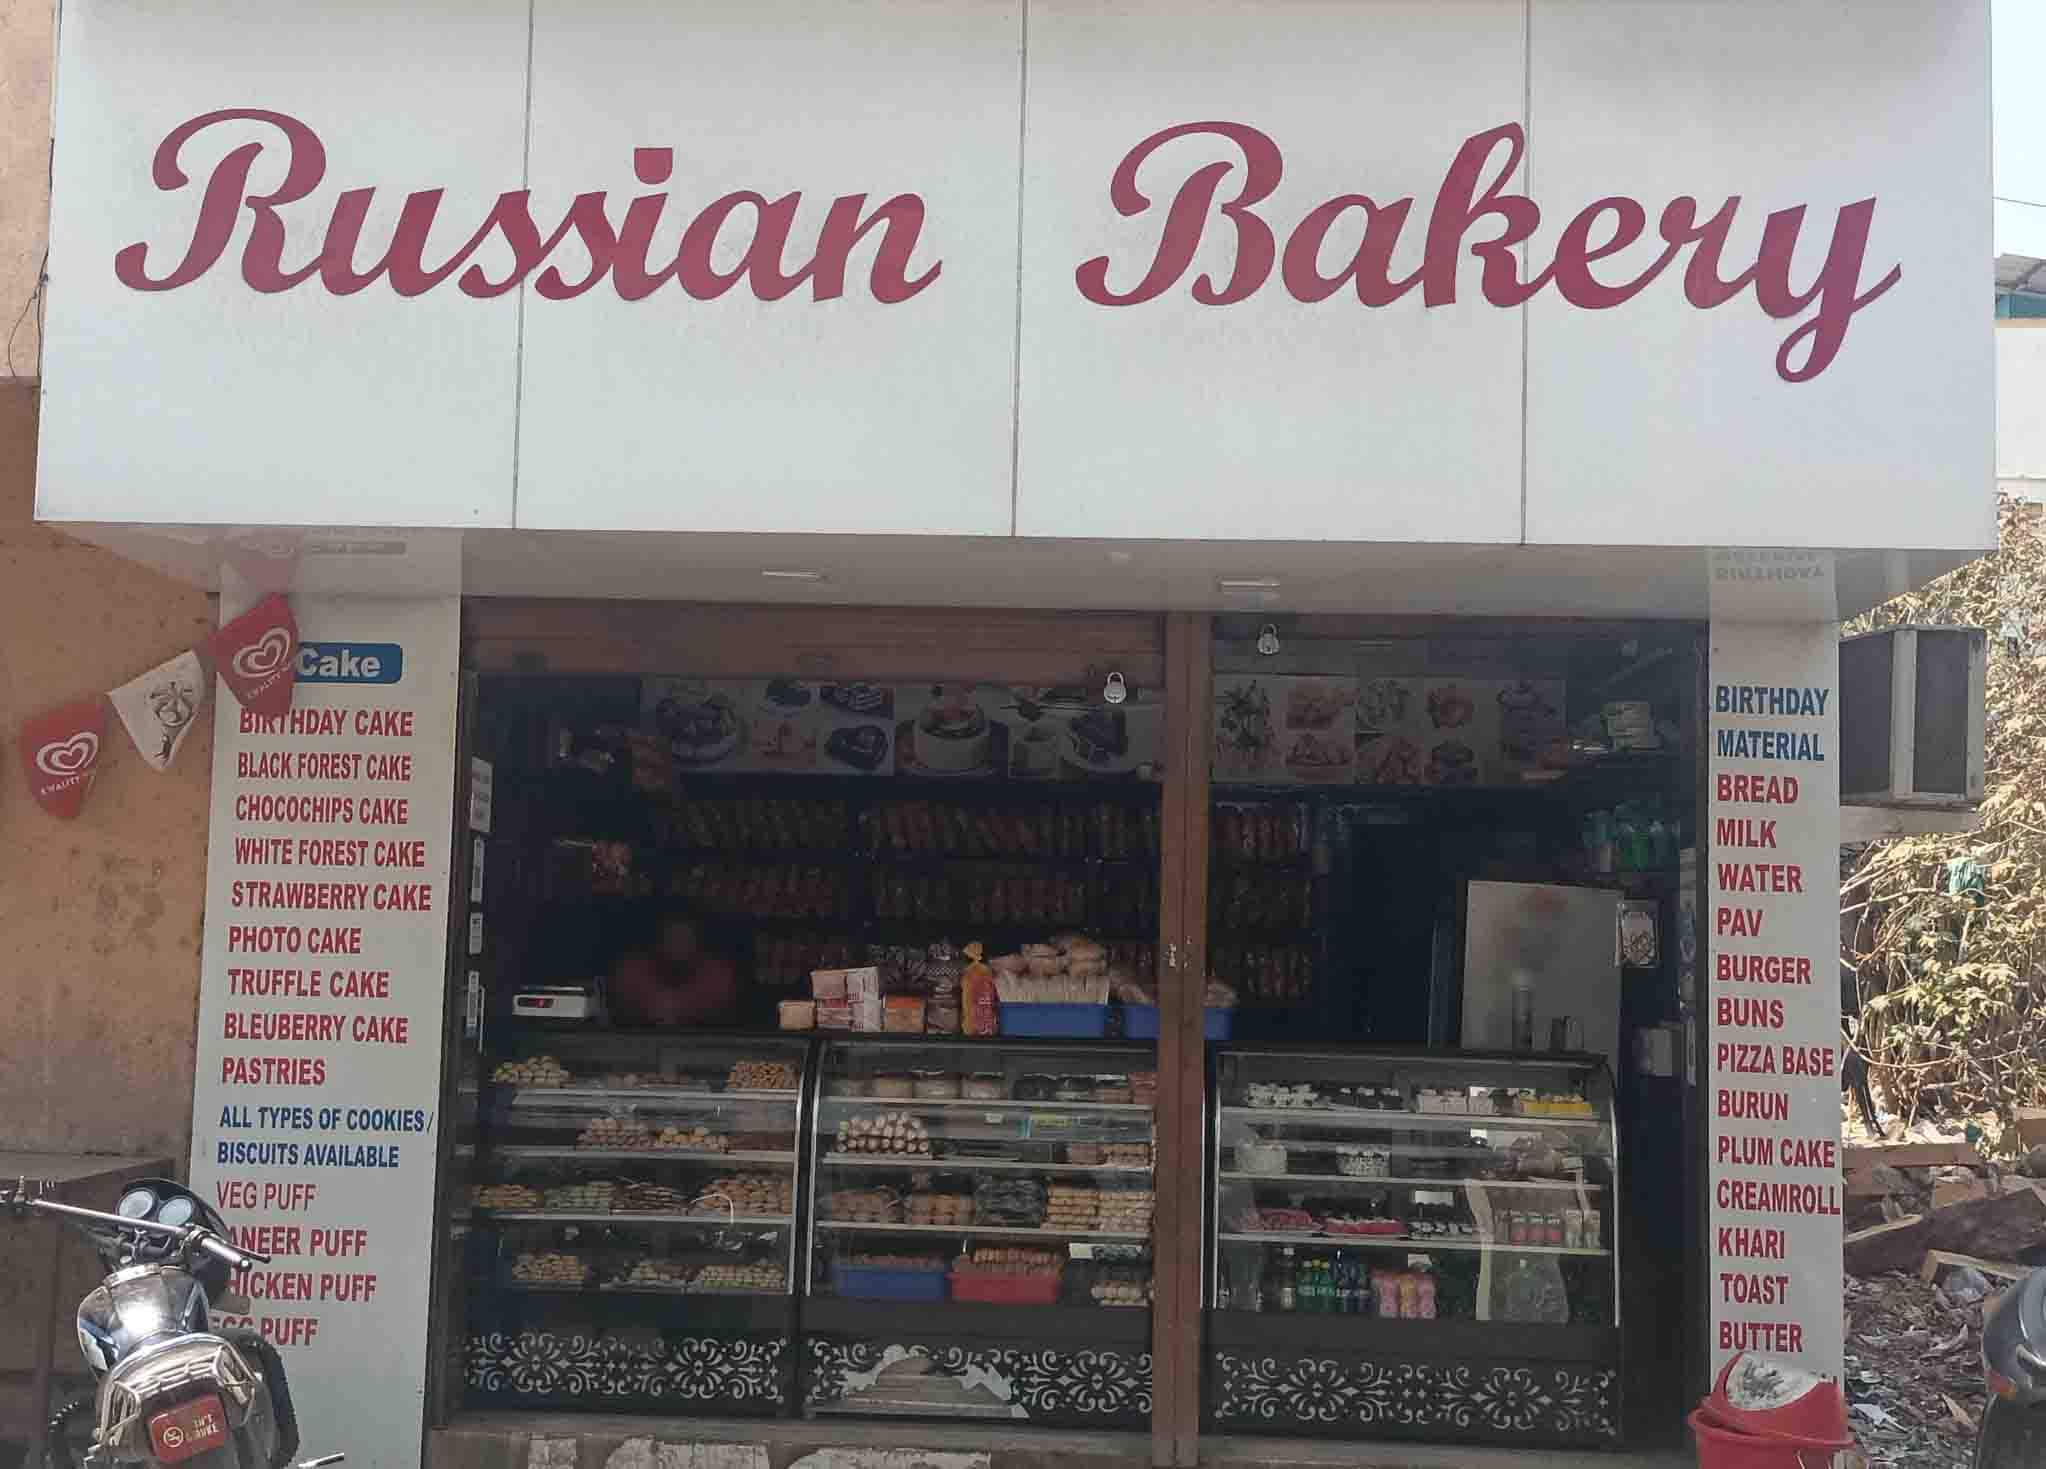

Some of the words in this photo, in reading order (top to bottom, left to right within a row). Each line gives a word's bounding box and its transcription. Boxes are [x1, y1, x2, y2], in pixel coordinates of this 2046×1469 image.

[115, 109, 941, 303] Russian
[1075, 122, 1900, 383] Bakery
[297, 647, 381, 677] Cake
[1716, 685, 1829, 716] BIRTHDAY
[240, 705, 346, 736] BIRTHDAY
[355, 710, 413, 736] CAKE
[1717, 729, 1824, 761] MATERIAL
[239, 752, 293, 779] BLACK
[298, 753, 361, 780] FOREST
[367, 755, 411, 783] CAKE
[1718, 774, 1798, 804] BREAD
[236, 794, 353, 824] CHOCOCHIPS
[359, 799, 408, 824] CAKE
[1717, 818, 1776, 848] MILK
[235, 837, 293, 864] WHITE
[299, 840, 368, 865] FOREST
[374, 841, 424, 868] CAKE
[1718, 864, 1801, 892] WATER
[232, 881, 368, 910] STRAWBERRY
[374, 884, 432, 911] CAKE
[1718, 907, 1762, 936] PAV
[229, 926, 301, 952] PHOTO
[308, 928, 361, 954] CAKE
[228, 968, 321, 996] TRUFFLE
[330, 970, 389, 998] CAKE
[1717, 954, 1810, 984] BURGER
[224, 1013, 346, 1042] BLEUBERRY
[353, 1016, 408, 1043] CAKE
[1717, 997, 1784, 1029] BUNS
[222, 1057, 325, 1084] PASTRIES
[1718, 1043, 1775, 1072] PIZZA
[1783, 1046, 1834, 1075] BASE
[220, 1106, 252, 1128] ALL
[258, 1107, 313, 1129] TYPES
[319, 1108, 342, 1130] OF
[1718, 1090, 1788, 1120] BURUN
[217, 1142, 298, 1165] BISCUITS
[304, 1144, 399, 1167] AVAILABLE
[1719, 1136, 1773, 1165] PLUM
[1781, 1139, 1835, 1168] CAKE
[217, 1180, 257, 1208] VEG
[264, 1183, 316, 1210] PUFF
[1717, 1179, 1840, 1215] CREAMROLL
[228, 1226, 300, 1255] ANEER
[310, 1228, 368, 1256] PUFF
[1719, 1229, 1784, 1259] KHARI
[227, 1271, 312, 1301] HICKEN
[320, 1274, 377, 1302] PUFF
[1720, 1273, 1788, 1303] TOAST
[260, 1318, 318, 1346] PUFF
[1720, 1321, 1801, 1352] BUTTER
